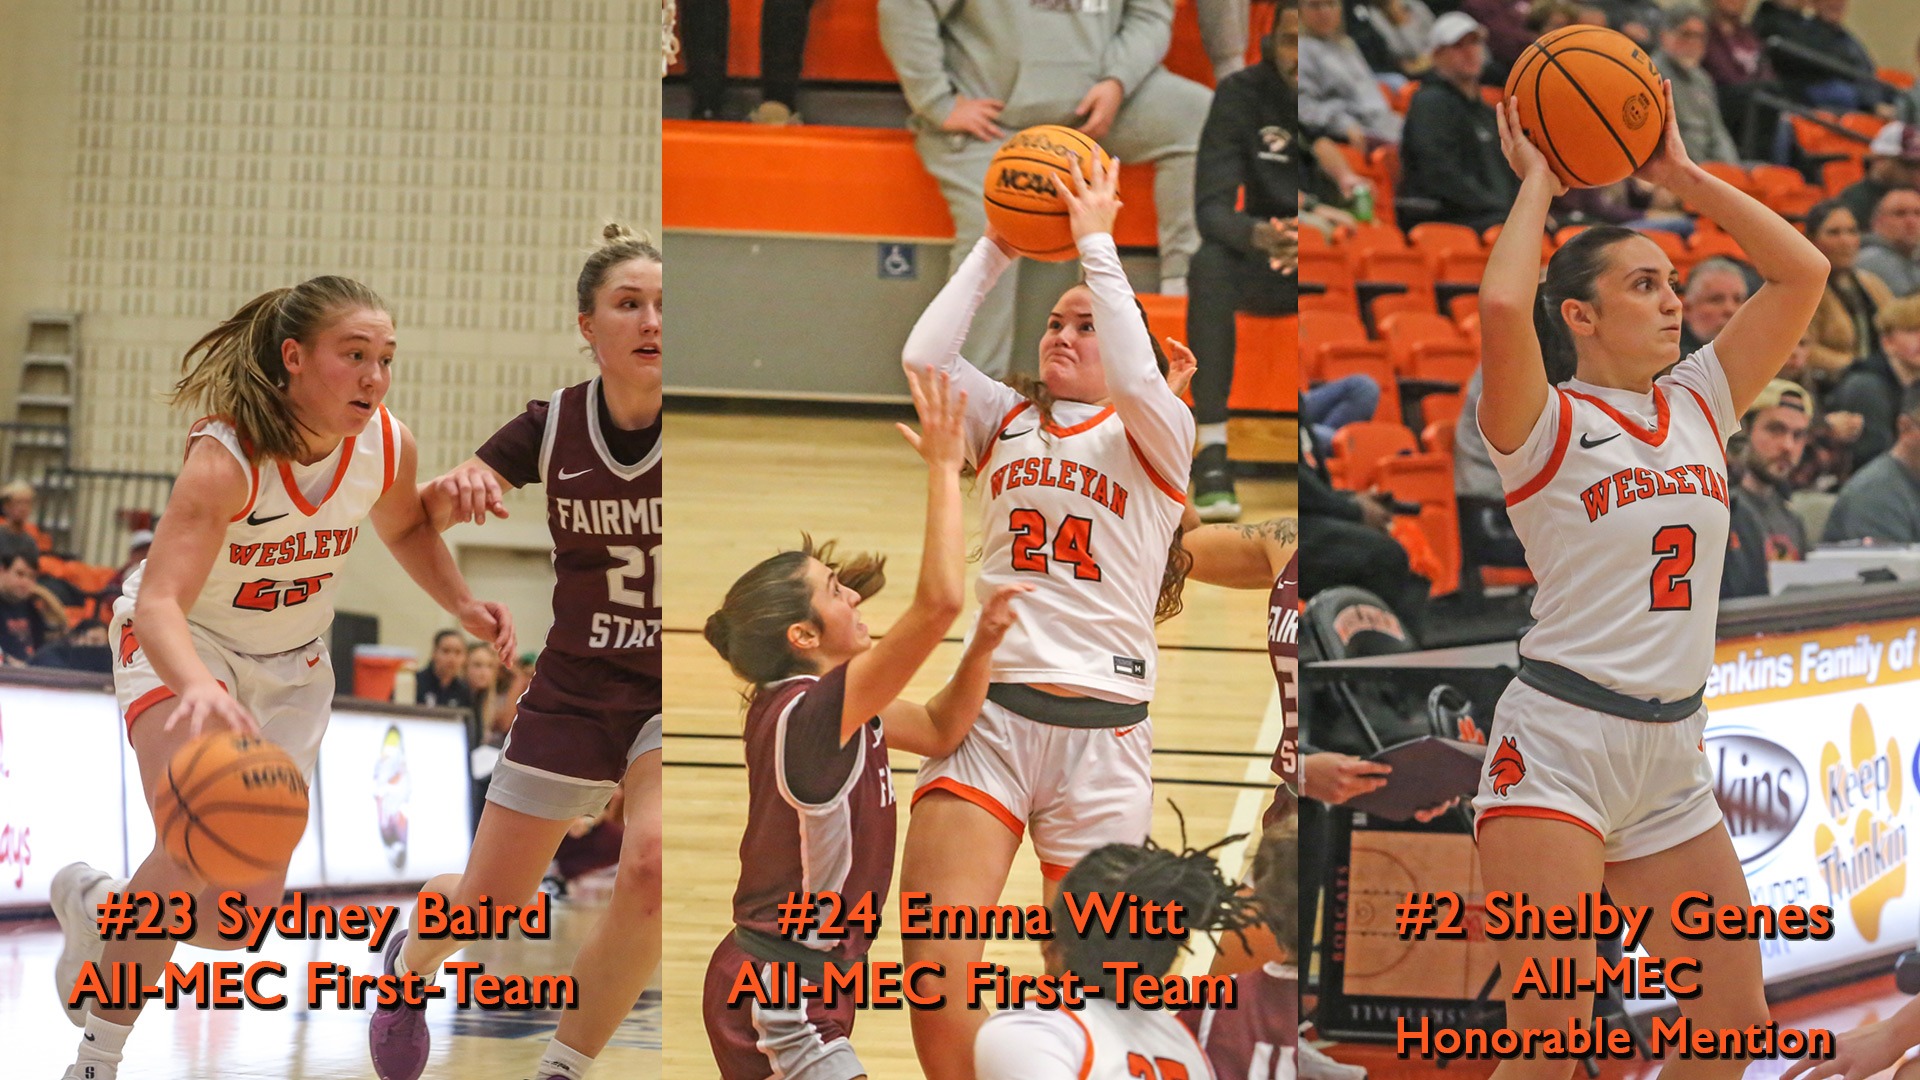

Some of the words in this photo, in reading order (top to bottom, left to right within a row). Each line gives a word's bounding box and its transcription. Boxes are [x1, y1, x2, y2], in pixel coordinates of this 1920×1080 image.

[990, 457, 1128, 520] WESLEYAN
[230, 526, 359, 567] WESLEYA
[1009, 508, 1101, 582] 24
[1648, 524, 1697, 612] 2
[588, 612, 662, 649] STAT
[1704, 649, 1794, 699] enkins
[1800, 635, 1883, 684] Family
[1888, 627, 1918, 671] of
[1718, 745, 1794, 837] kins
[1828, 755, 1890, 820] Keep
